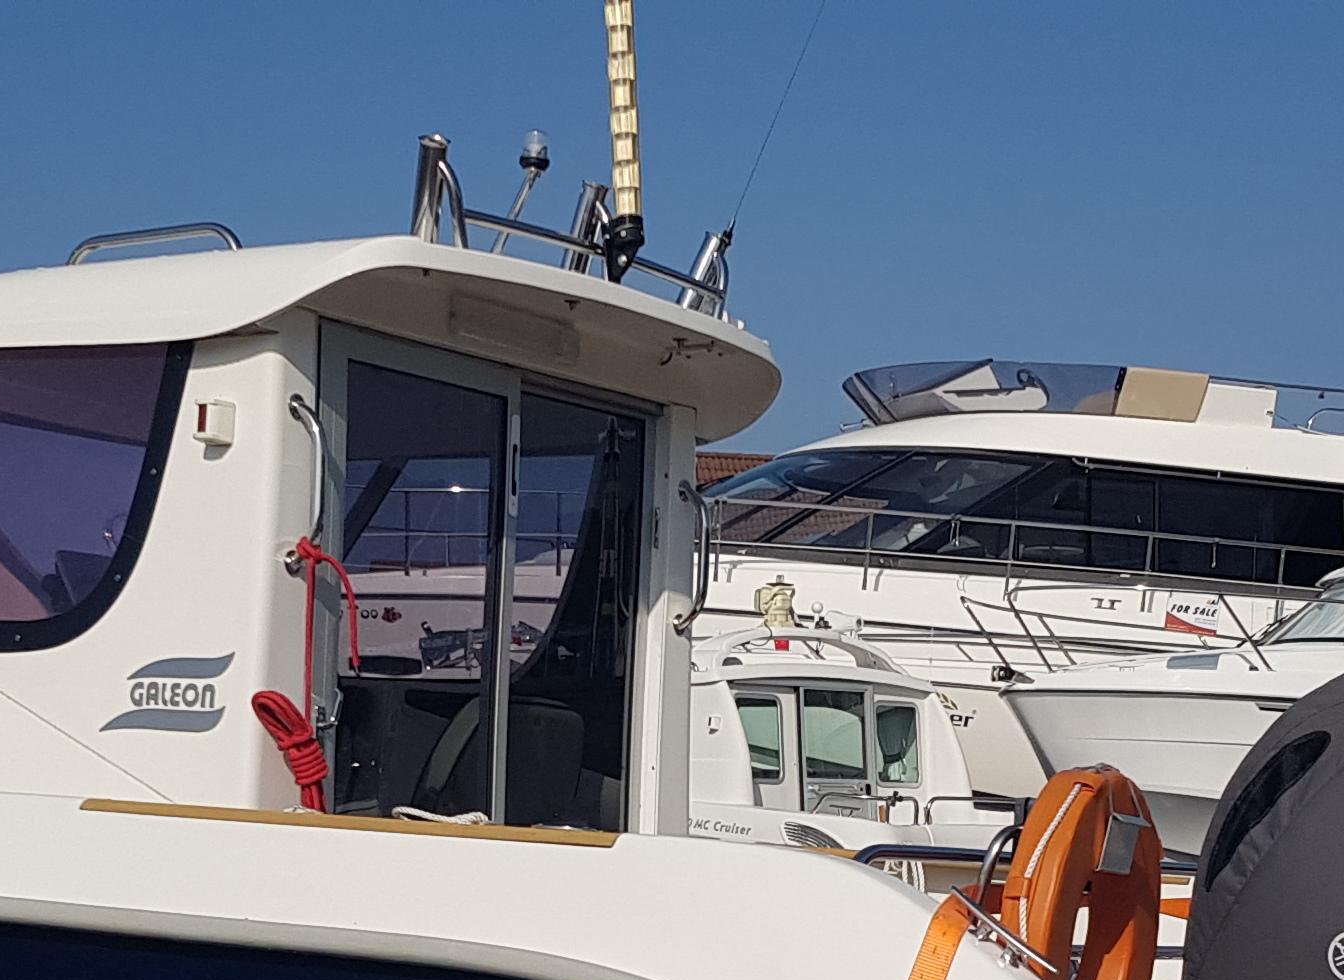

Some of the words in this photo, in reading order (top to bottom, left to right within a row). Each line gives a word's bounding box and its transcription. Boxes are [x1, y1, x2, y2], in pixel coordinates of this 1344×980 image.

[1171, 603, 1191, 614] FOR
[1192, 606, 1218, 617] SALE
[129, 681, 216, 708] GALEON
[713, 820, 752, 836] Cruiser
